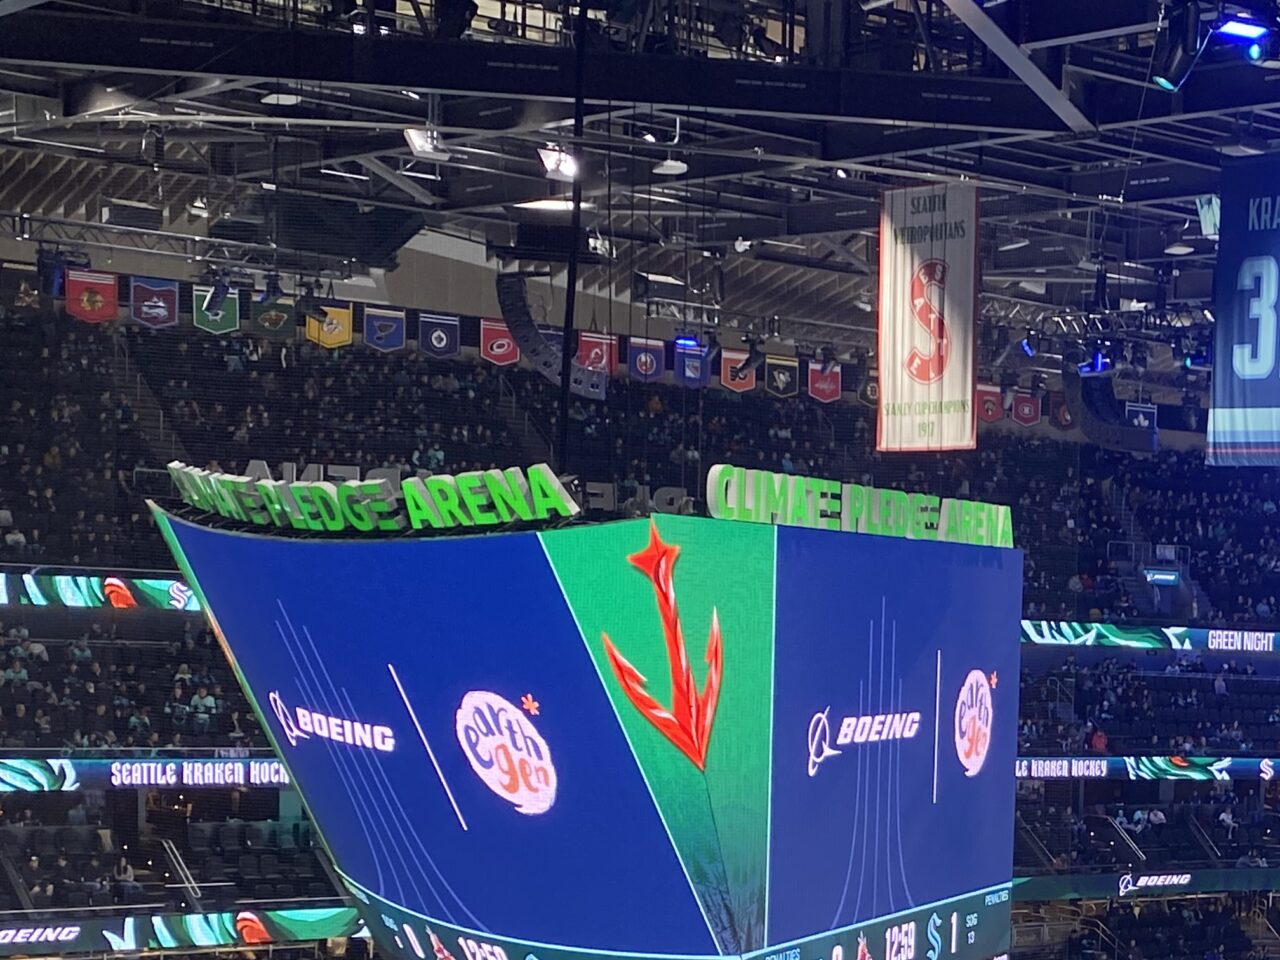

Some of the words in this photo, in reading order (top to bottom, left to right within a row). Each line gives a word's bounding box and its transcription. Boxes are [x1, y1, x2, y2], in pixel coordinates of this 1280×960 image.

[401, 463, 580, 529] ARENA
[706, 464, 841, 531] CLIMATE
[939, 498, 1014, 549] ARENA
[1208, 630, 1241, 650] GREEN
[1243, 632, 1275, 652] NIGHT
[296, 706, 395, 751] BOEING
[463, 702, 541, 768] earth
[837, 711, 920, 746] BOEING
[111, 762, 177, 785] SEATTLE
[182, 761, 244, 785] KRAKEN
[250, 761, 290, 785] HOCK
[1031, 758, 1068, 777] KRAKEN
[1071, 758, 1107, 777] HOCKEY
[1136, 874, 1191, 888] BOEING
[0, 926, 80, 943] OEING
[951, 912, 958, 953] 1
